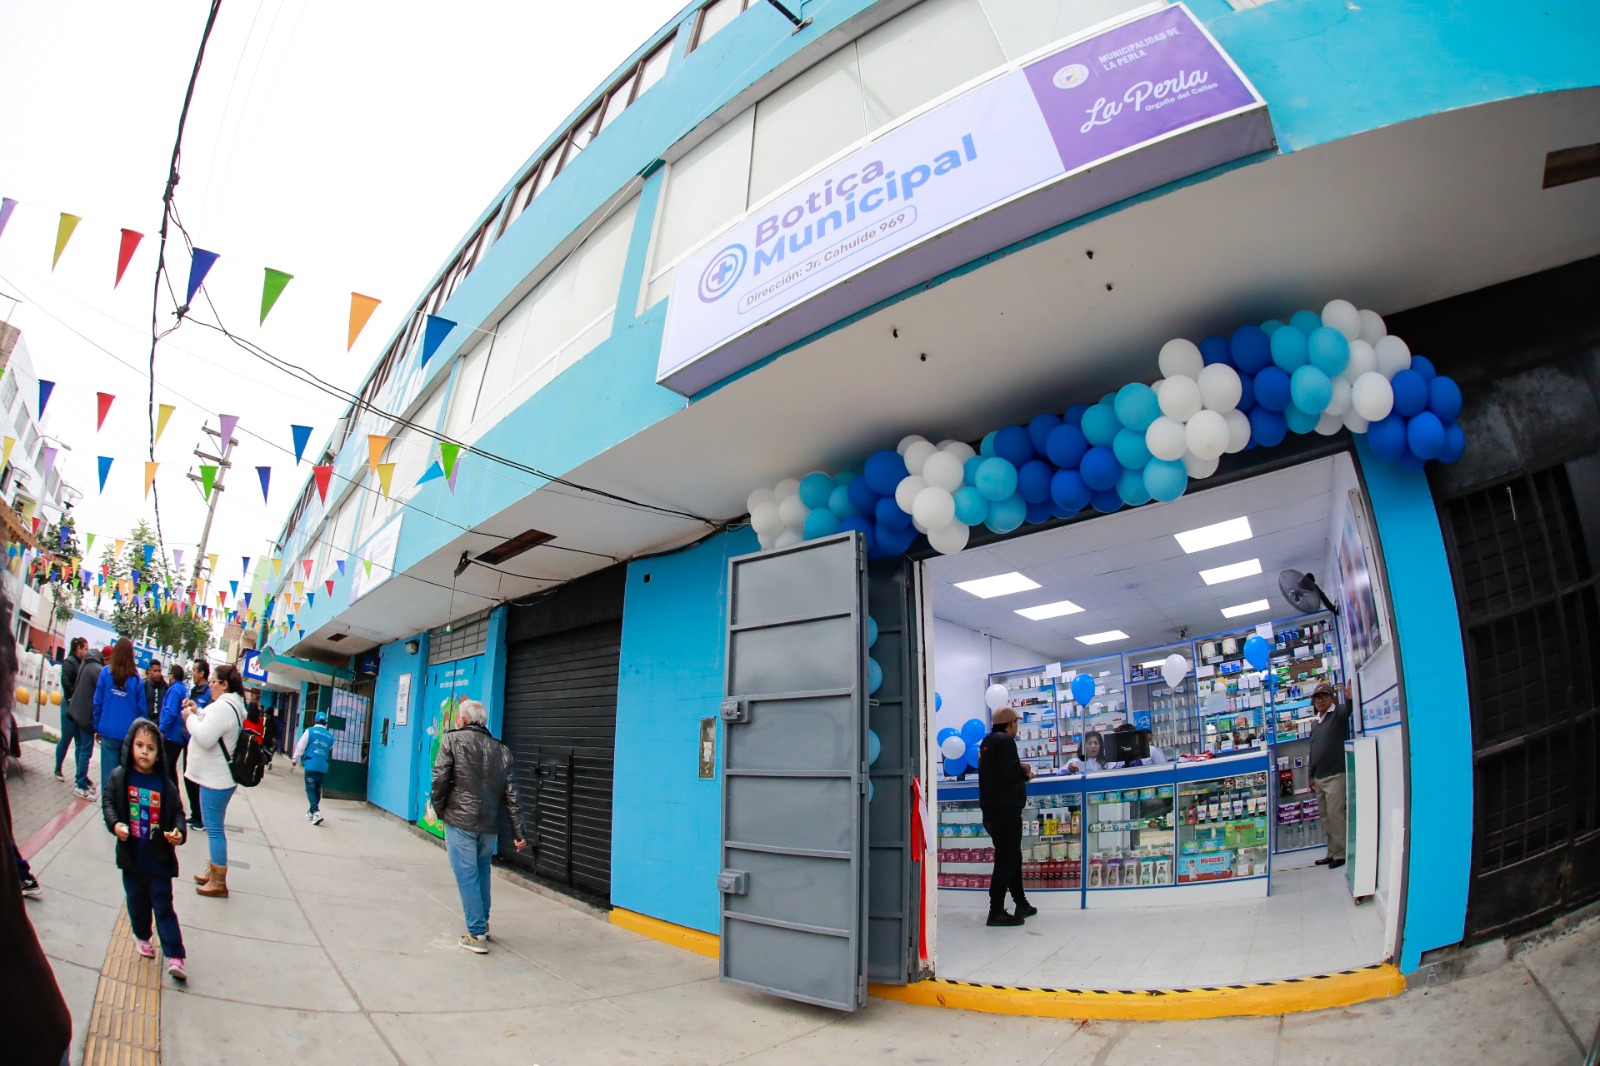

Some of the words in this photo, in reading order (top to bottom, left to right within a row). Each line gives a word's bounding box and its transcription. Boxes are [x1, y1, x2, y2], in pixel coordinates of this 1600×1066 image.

[1098, 32, 1166, 64] MUNICIPALIDAD
[1168, 28, 1181, 37] DE
[1102, 62, 1117, 72] LA
[1117, 49, 1147, 67] PERLA
[1080, 97, 1123, 134] La
[1123, 69, 1208, 112] Perla
[1144, 96, 1176, 112] Orgullo
[1176, 91, 1191, 101] del
[1191, 82, 1218, 95] Callao
[752, 133, 978, 277] Municipal
[755, 159, 885, 248] Botica
[746, 268, 804, 306] Dirección:
[805, 258, 822, 273] Jr.
[823, 229, 877, 263] Cahuide
[879, 213, 906, 234] 969
[1200, 856, 1225, 865] HUGGIES
